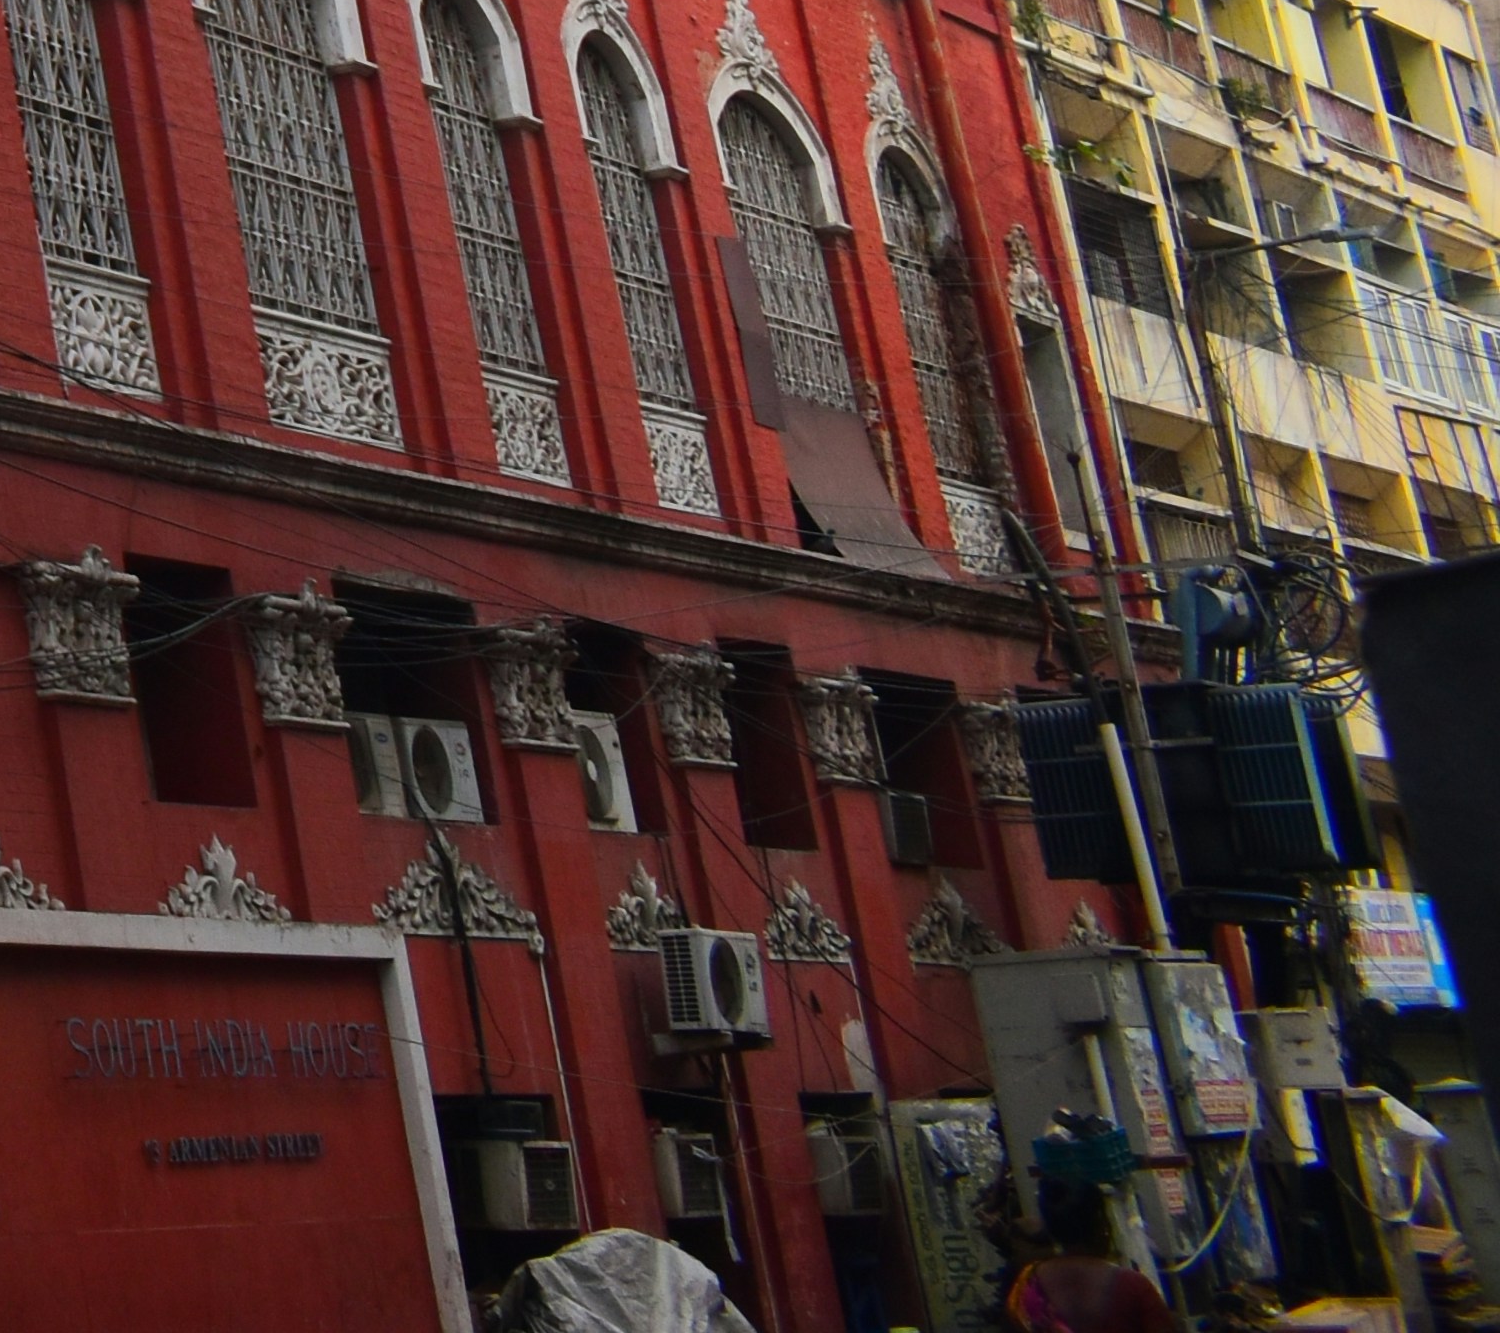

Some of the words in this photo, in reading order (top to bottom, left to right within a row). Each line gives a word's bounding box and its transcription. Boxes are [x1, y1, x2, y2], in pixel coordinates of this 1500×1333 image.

[66, 1016, 184, 1078] SOUTH
[193, 1018, 277, 1078] INDIA
[286, 1021, 386, 1078] HOUSE
[168, 1135, 262, 1163] ARMENIAN
[265, 1132, 323, 1159] STREET
